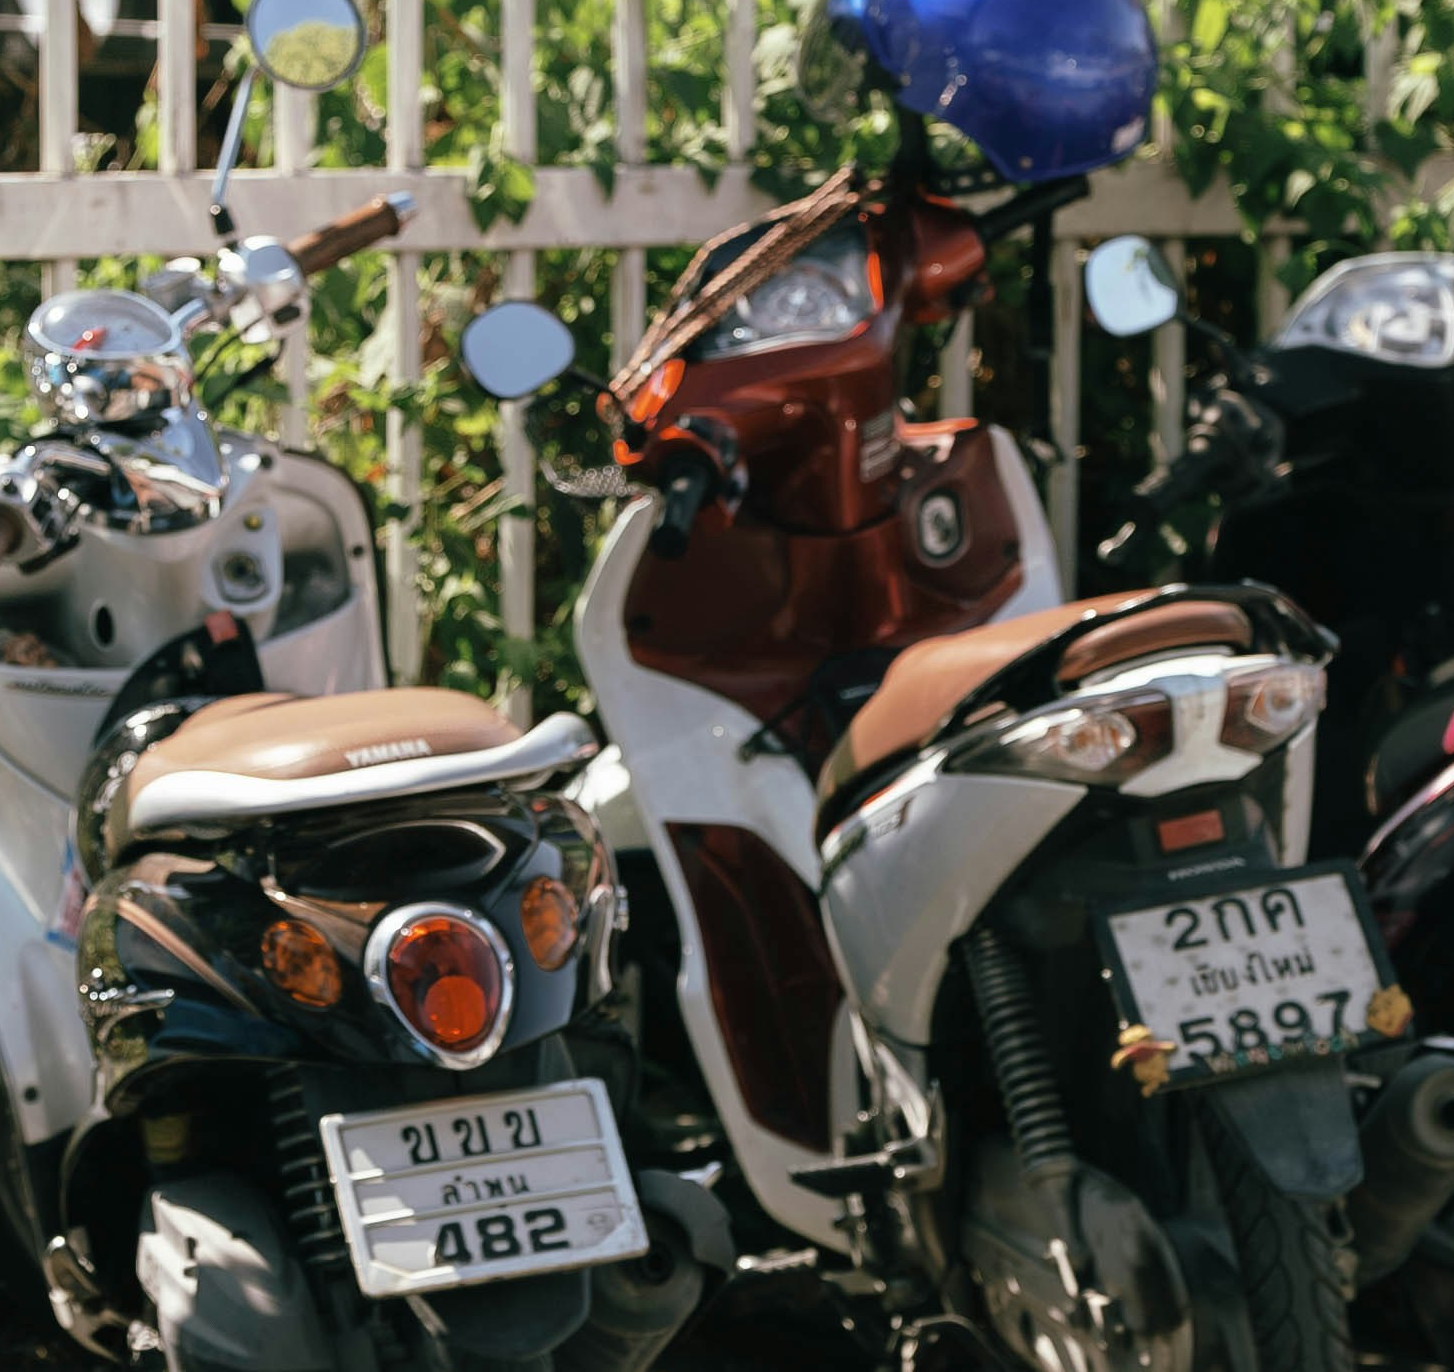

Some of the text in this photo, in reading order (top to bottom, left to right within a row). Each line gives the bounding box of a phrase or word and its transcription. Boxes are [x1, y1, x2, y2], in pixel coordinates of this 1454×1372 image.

[343, 738, 432, 768] YAMAHA
[1178, 989, 1352, 1062] 5897
[435, 1206, 571, 1266] 482
